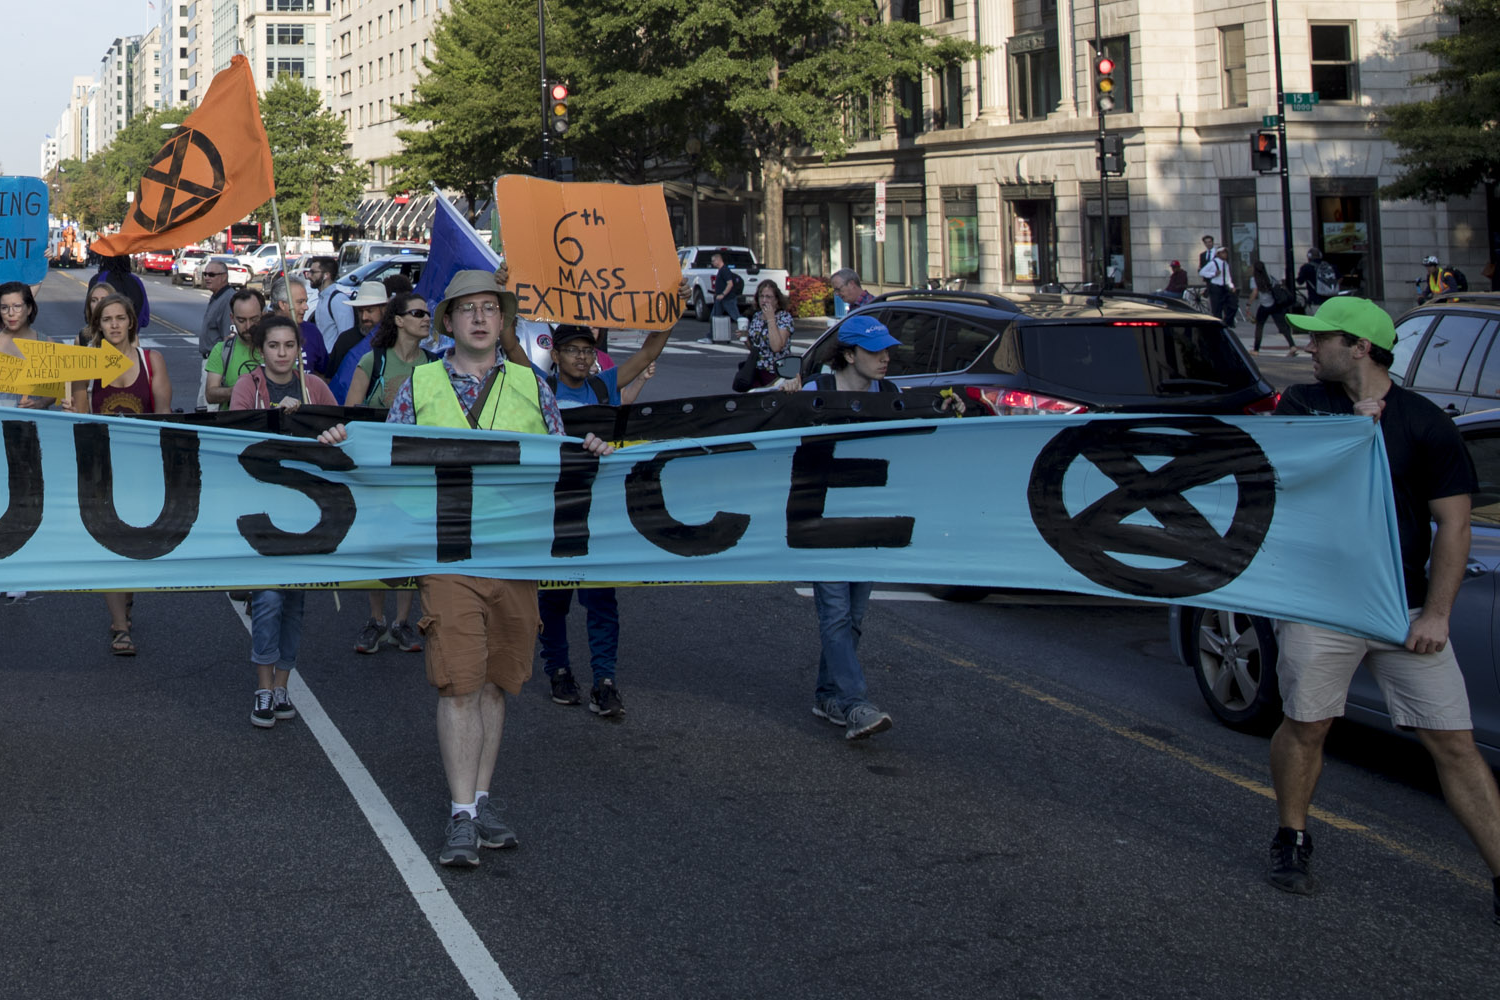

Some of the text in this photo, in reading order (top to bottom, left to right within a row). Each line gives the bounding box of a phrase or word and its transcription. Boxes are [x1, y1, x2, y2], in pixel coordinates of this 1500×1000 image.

[1293, 94, 1303, 103] 15
[558, 266, 626, 290] MASS
[515, 283, 681, 323] EXTINCTION
[23, 343, 56, 354] STOP!
[30, 355, 98, 369] EXTINCTION
[26, 368, 60, 379] AHEAD
